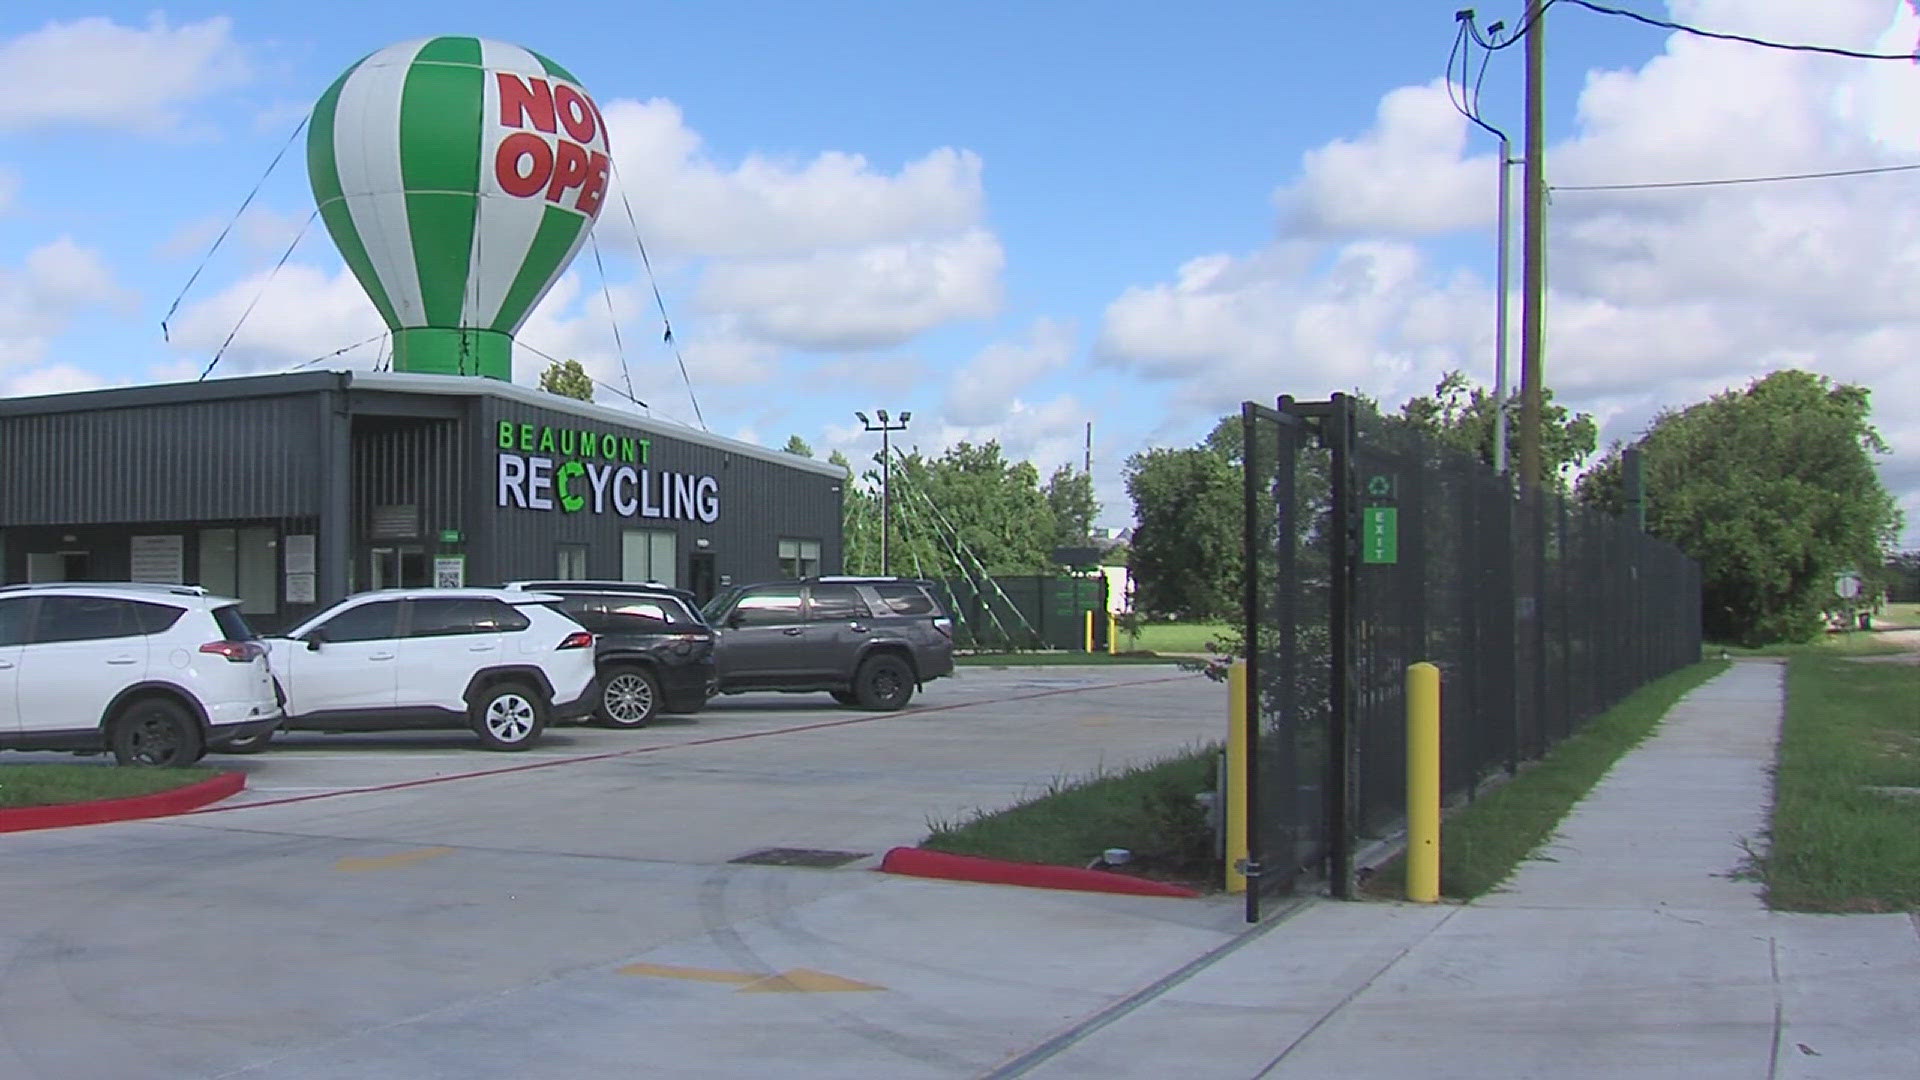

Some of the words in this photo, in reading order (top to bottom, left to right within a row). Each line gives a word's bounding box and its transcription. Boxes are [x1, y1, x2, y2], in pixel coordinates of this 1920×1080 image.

[496, 72, 611, 155] NO
[495, 132, 610, 218] OPE
[498, 421, 650, 464] BEAUMONT
[498, 453, 720, 523] RECYCLING
[1374, 511, 1385, 560] EXIT
